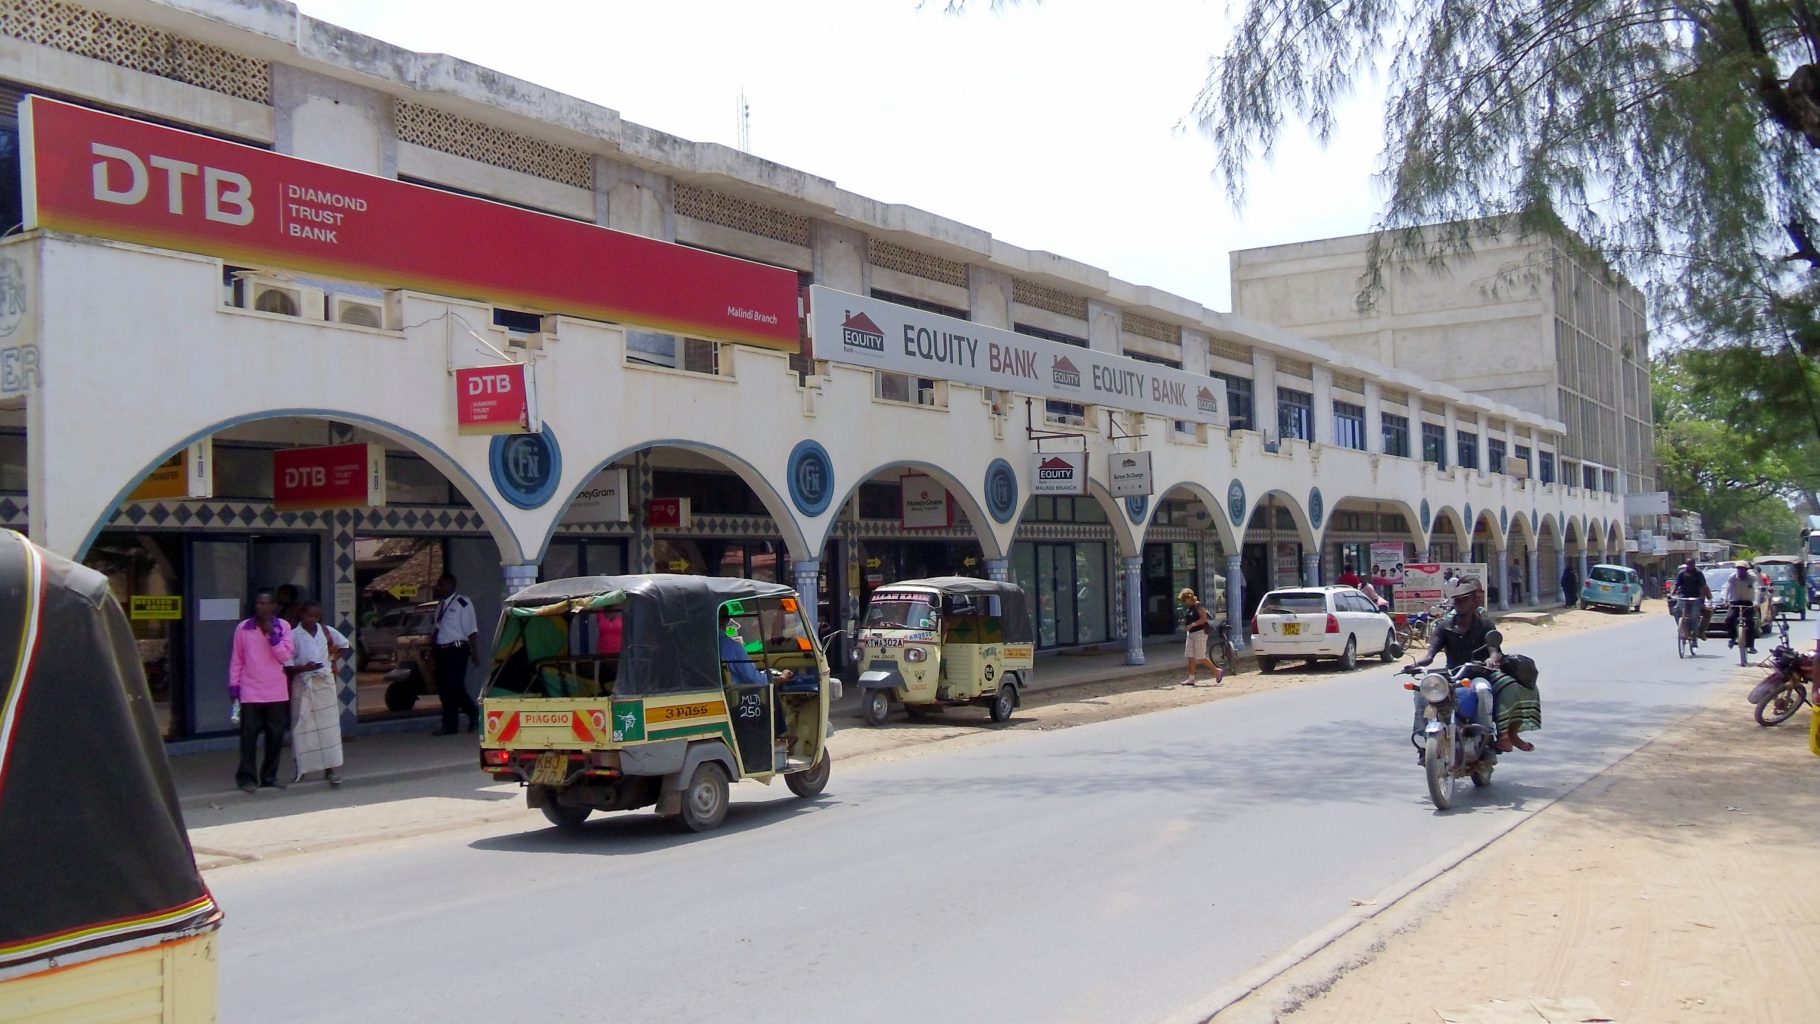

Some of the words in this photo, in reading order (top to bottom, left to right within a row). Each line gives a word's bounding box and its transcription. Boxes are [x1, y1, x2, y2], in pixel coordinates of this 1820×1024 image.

[91, 142, 255, 226] DTB
[288, 184, 368, 212] DIAMOND
[289, 204, 344, 226] TRUST
[289, 223, 338, 244] BANK
[728, 306, 753, 320] Malindi
[754, 311, 778, 325] Branch
[845, 330, 883, 349] EQUITY
[903, 323, 978, 368] EQUITY
[988, 342, 1039, 380] BANK
[468, 374, 511, 396] DTB
[1054, 371, 1080, 387] EQUITY
[1092, 364, 1145, 399] EQUITY
[1151, 377, 1188, 407] BANK
[285, 466, 326, 488] DTB
[1040, 470, 1072, 479] EQUITY
[525, 714, 569, 724] PIAGGIO
[665, 708, 675, 719] 3
[740, 706, 761, 718] 250
